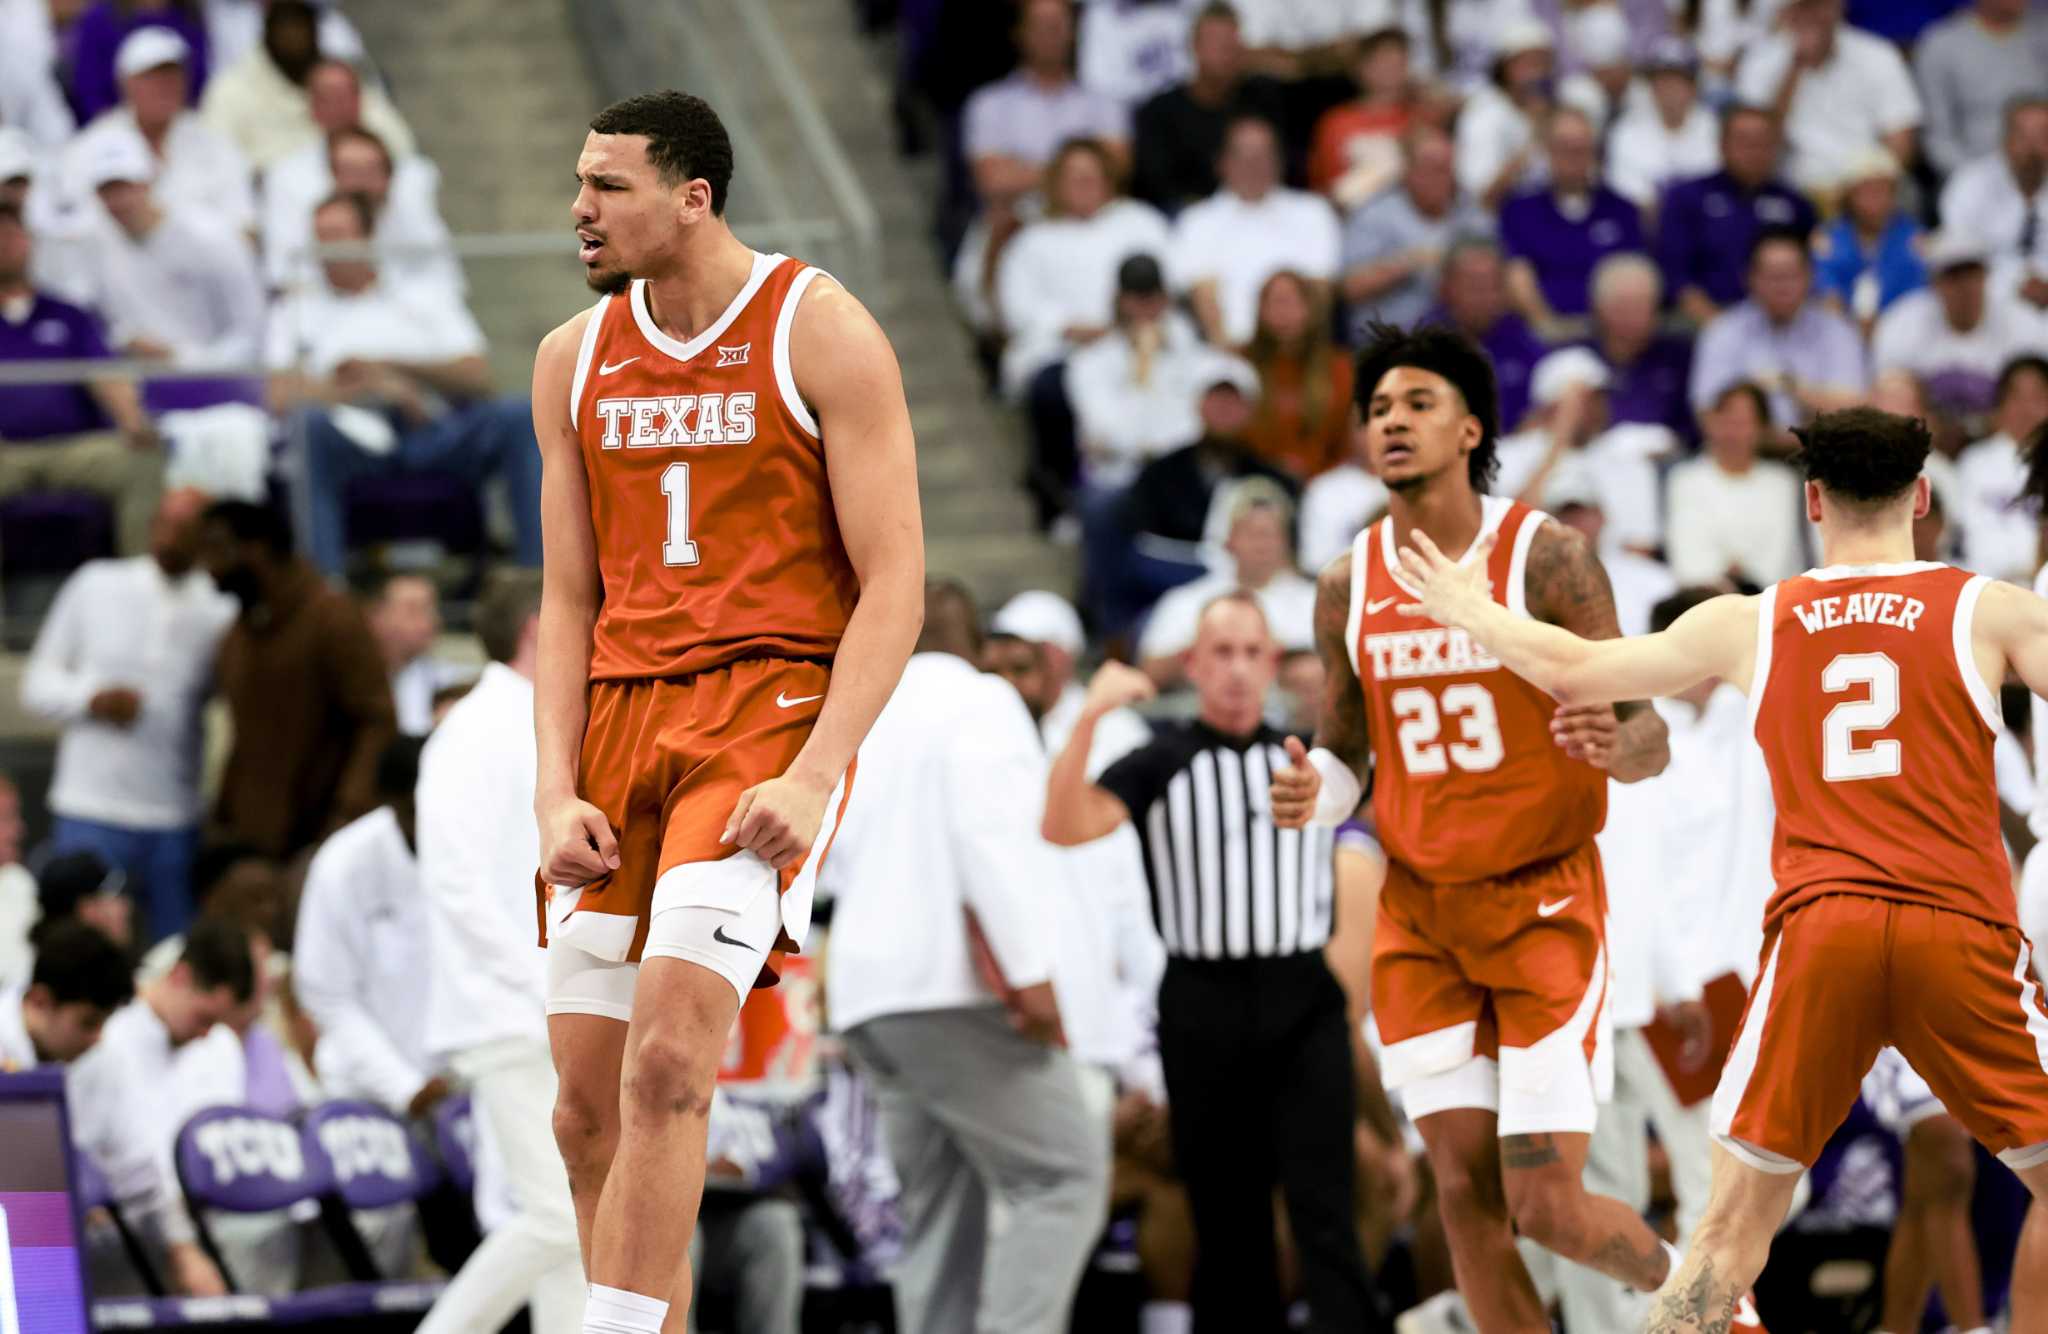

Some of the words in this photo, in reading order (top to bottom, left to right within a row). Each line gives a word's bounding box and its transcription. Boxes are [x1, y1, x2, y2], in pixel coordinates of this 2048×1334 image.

[716, 342, 751, 367] XII
[597, 392, 756, 449] TEXAS
[661, 462, 700, 567] 1
[1792, 592, 1925, 635] WEAVER
[1391, 683, 1505, 775] 23
[1821, 651, 1901, 782] 2
[195, 1117, 302, 1185] TCU
[318, 1116, 414, 1182] TCU
